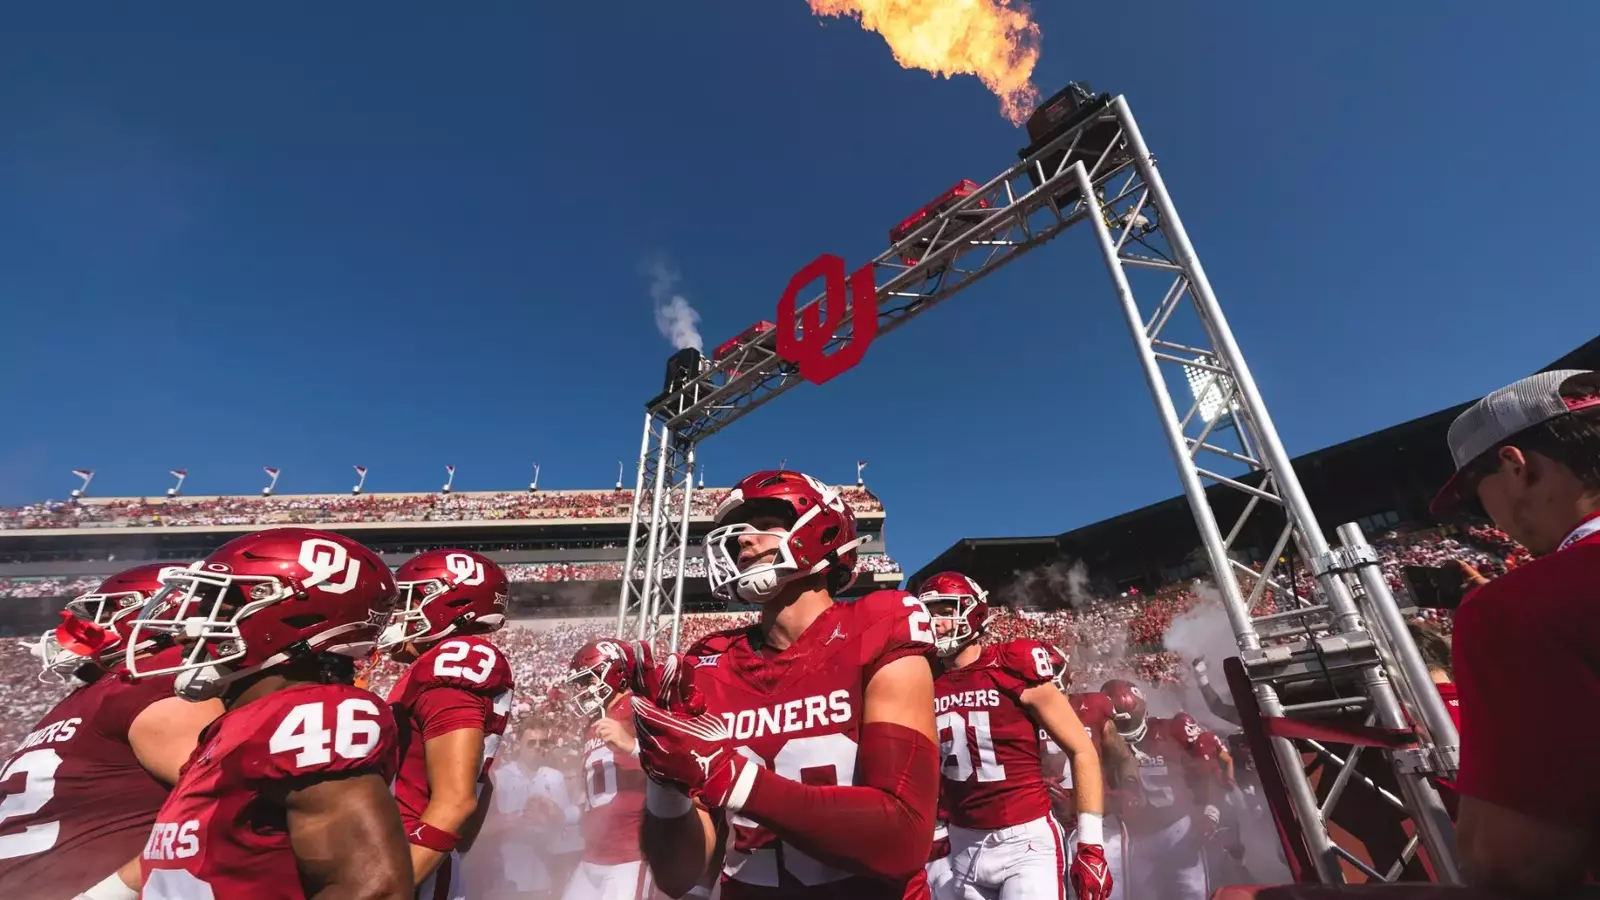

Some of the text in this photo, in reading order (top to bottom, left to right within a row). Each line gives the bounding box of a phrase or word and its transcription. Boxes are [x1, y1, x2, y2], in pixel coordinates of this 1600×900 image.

[776, 253, 878, 385] OU
[298, 538, 360, 594] OU
[446, 554, 484, 586] OU
[434, 641, 496, 683] 23
[269, 698, 381, 768] 46
